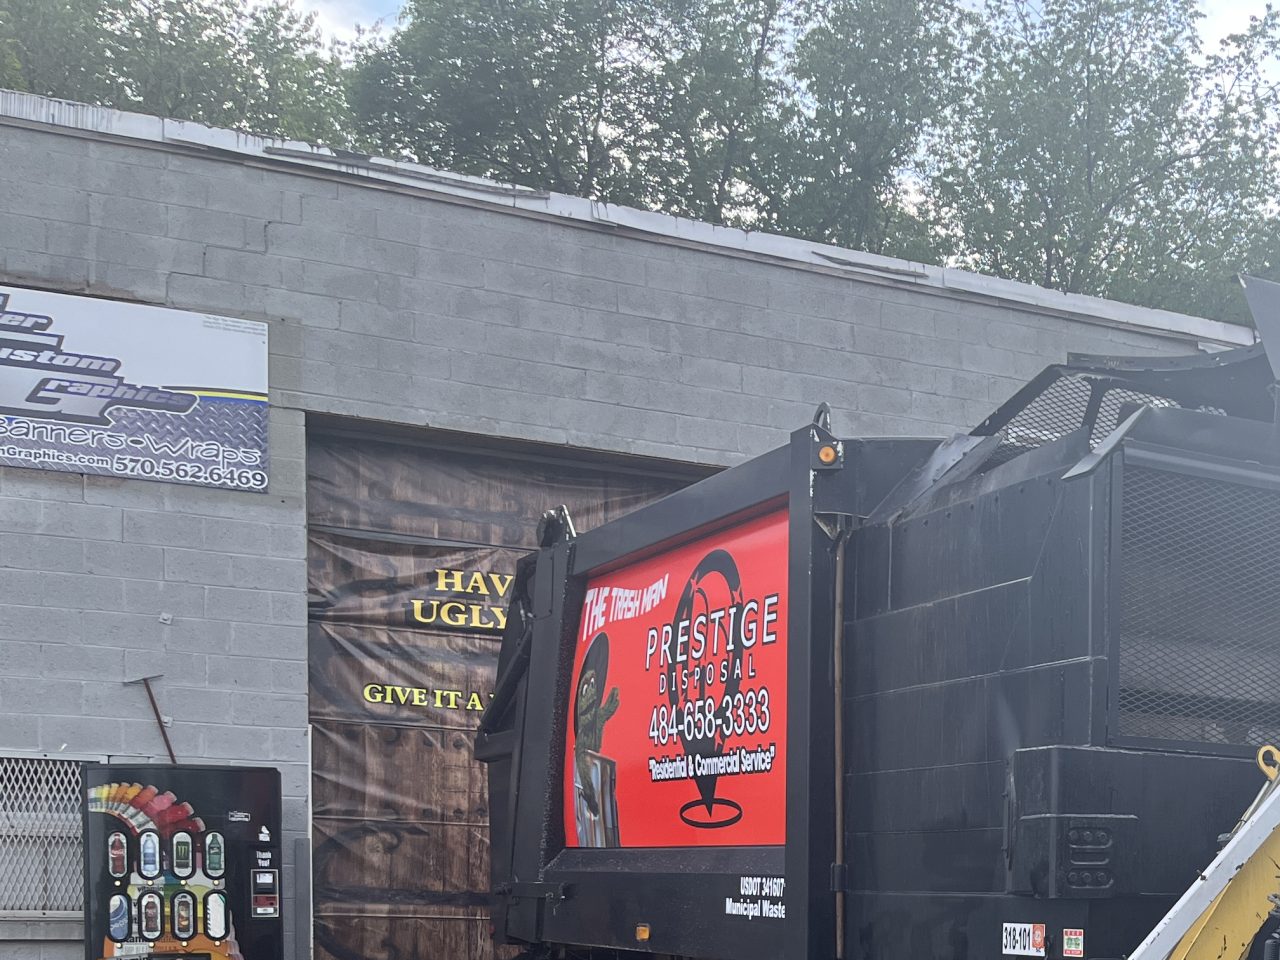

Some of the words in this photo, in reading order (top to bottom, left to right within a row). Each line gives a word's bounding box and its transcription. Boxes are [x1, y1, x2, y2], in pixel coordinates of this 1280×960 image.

[114, 455, 268, 488] 570.562.6469
[582, 586, 611, 642] THE
[609, 587, 643, 623] TRASH
[641, 573, 670, 616] MAN
[645, 594, 779, 671] PRESTIGE
[659, 654, 756, 694] DISPOSAL
[363, 684, 429, 706] GIVE
[433, 689, 462, 709] IT
[466, 693, 485, 711] A
[648, 687, 771, 746] 484-658-3333
[687, 754, 695, 777] &
[695, 749, 740, 776] Commercial
[740, 876, 762, 896] USDOT
[761, 877, 786, 898] 341607
[725, 897, 761, 920] Municipal
[762, 899, 786, 919] Waste
[1003, 926, 1031, 951] 318-101
